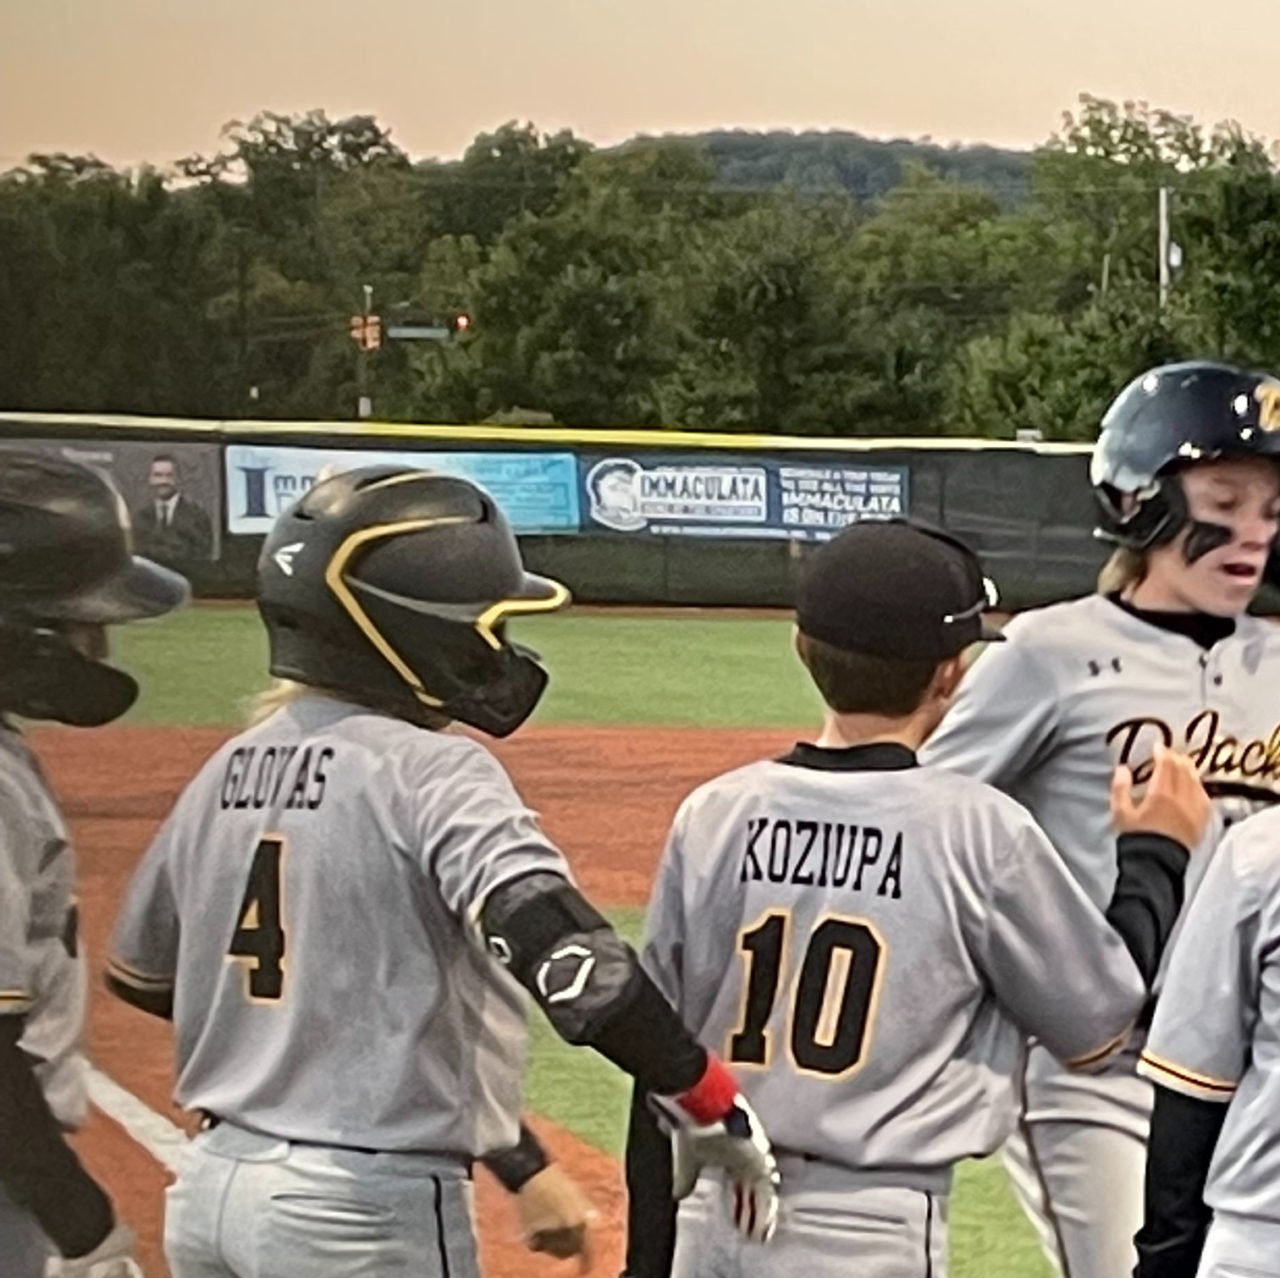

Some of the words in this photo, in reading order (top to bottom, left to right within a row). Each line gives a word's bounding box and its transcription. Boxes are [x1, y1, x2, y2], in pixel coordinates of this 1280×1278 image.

[640, 475, 762, 502] IMMACULATA
[782, 491, 902, 514] IMMACULATA
[739, 817, 905, 900] KOZIUPA
[226, 831, 289, 1006] 4
[727, 908, 888, 1082] 10
